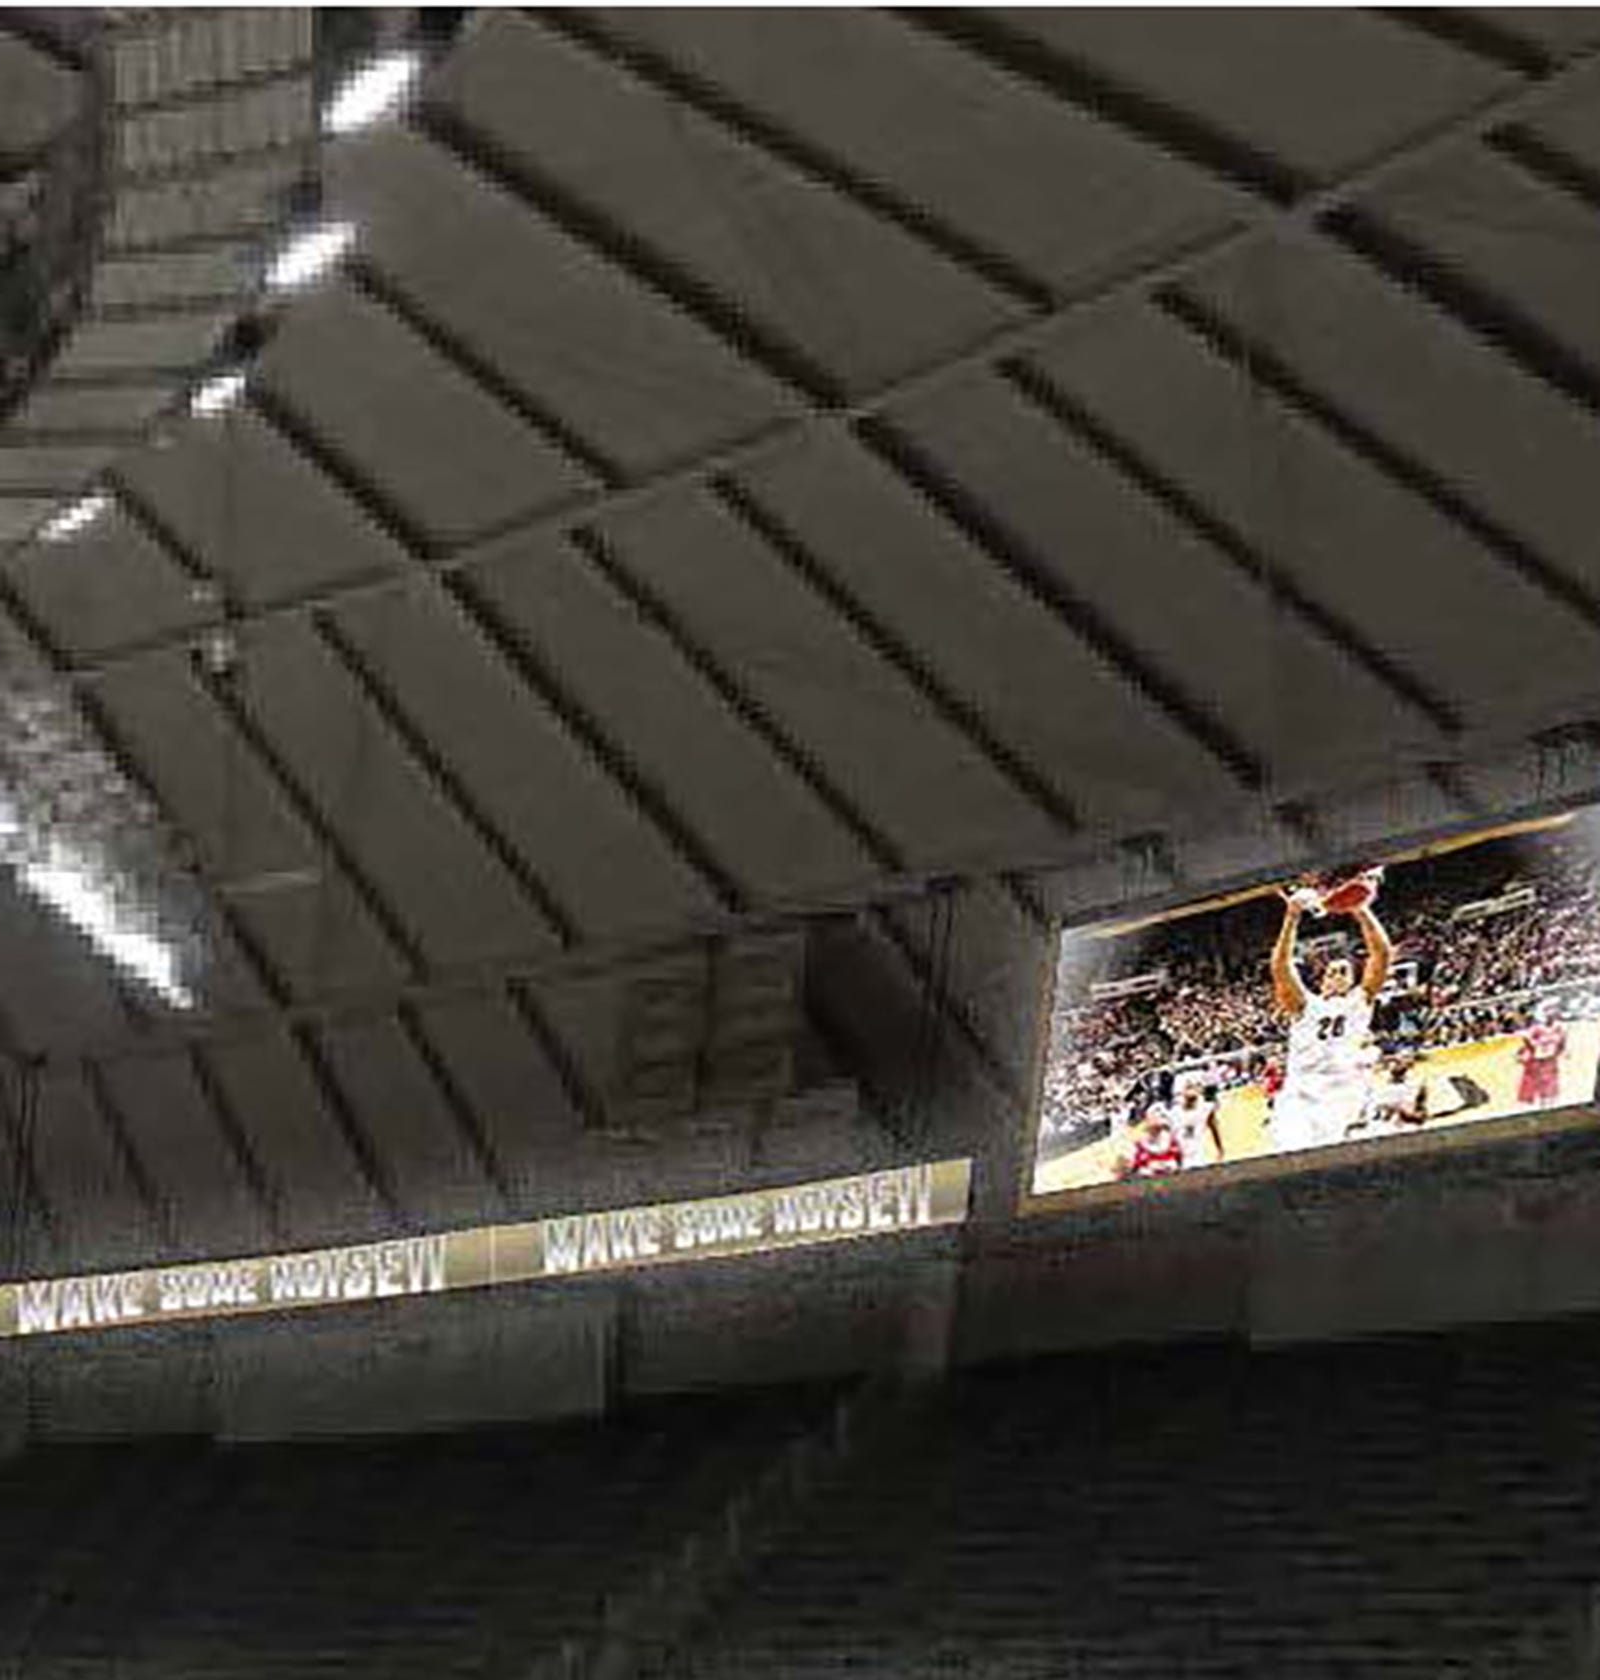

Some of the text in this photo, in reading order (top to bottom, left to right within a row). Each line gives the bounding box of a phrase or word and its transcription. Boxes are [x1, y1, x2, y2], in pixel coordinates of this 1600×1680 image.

[541, 1202, 660, 1275] MAKE
[14, 1270, 146, 1334] MAKE
[156, 1262, 261, 1312] SOME
